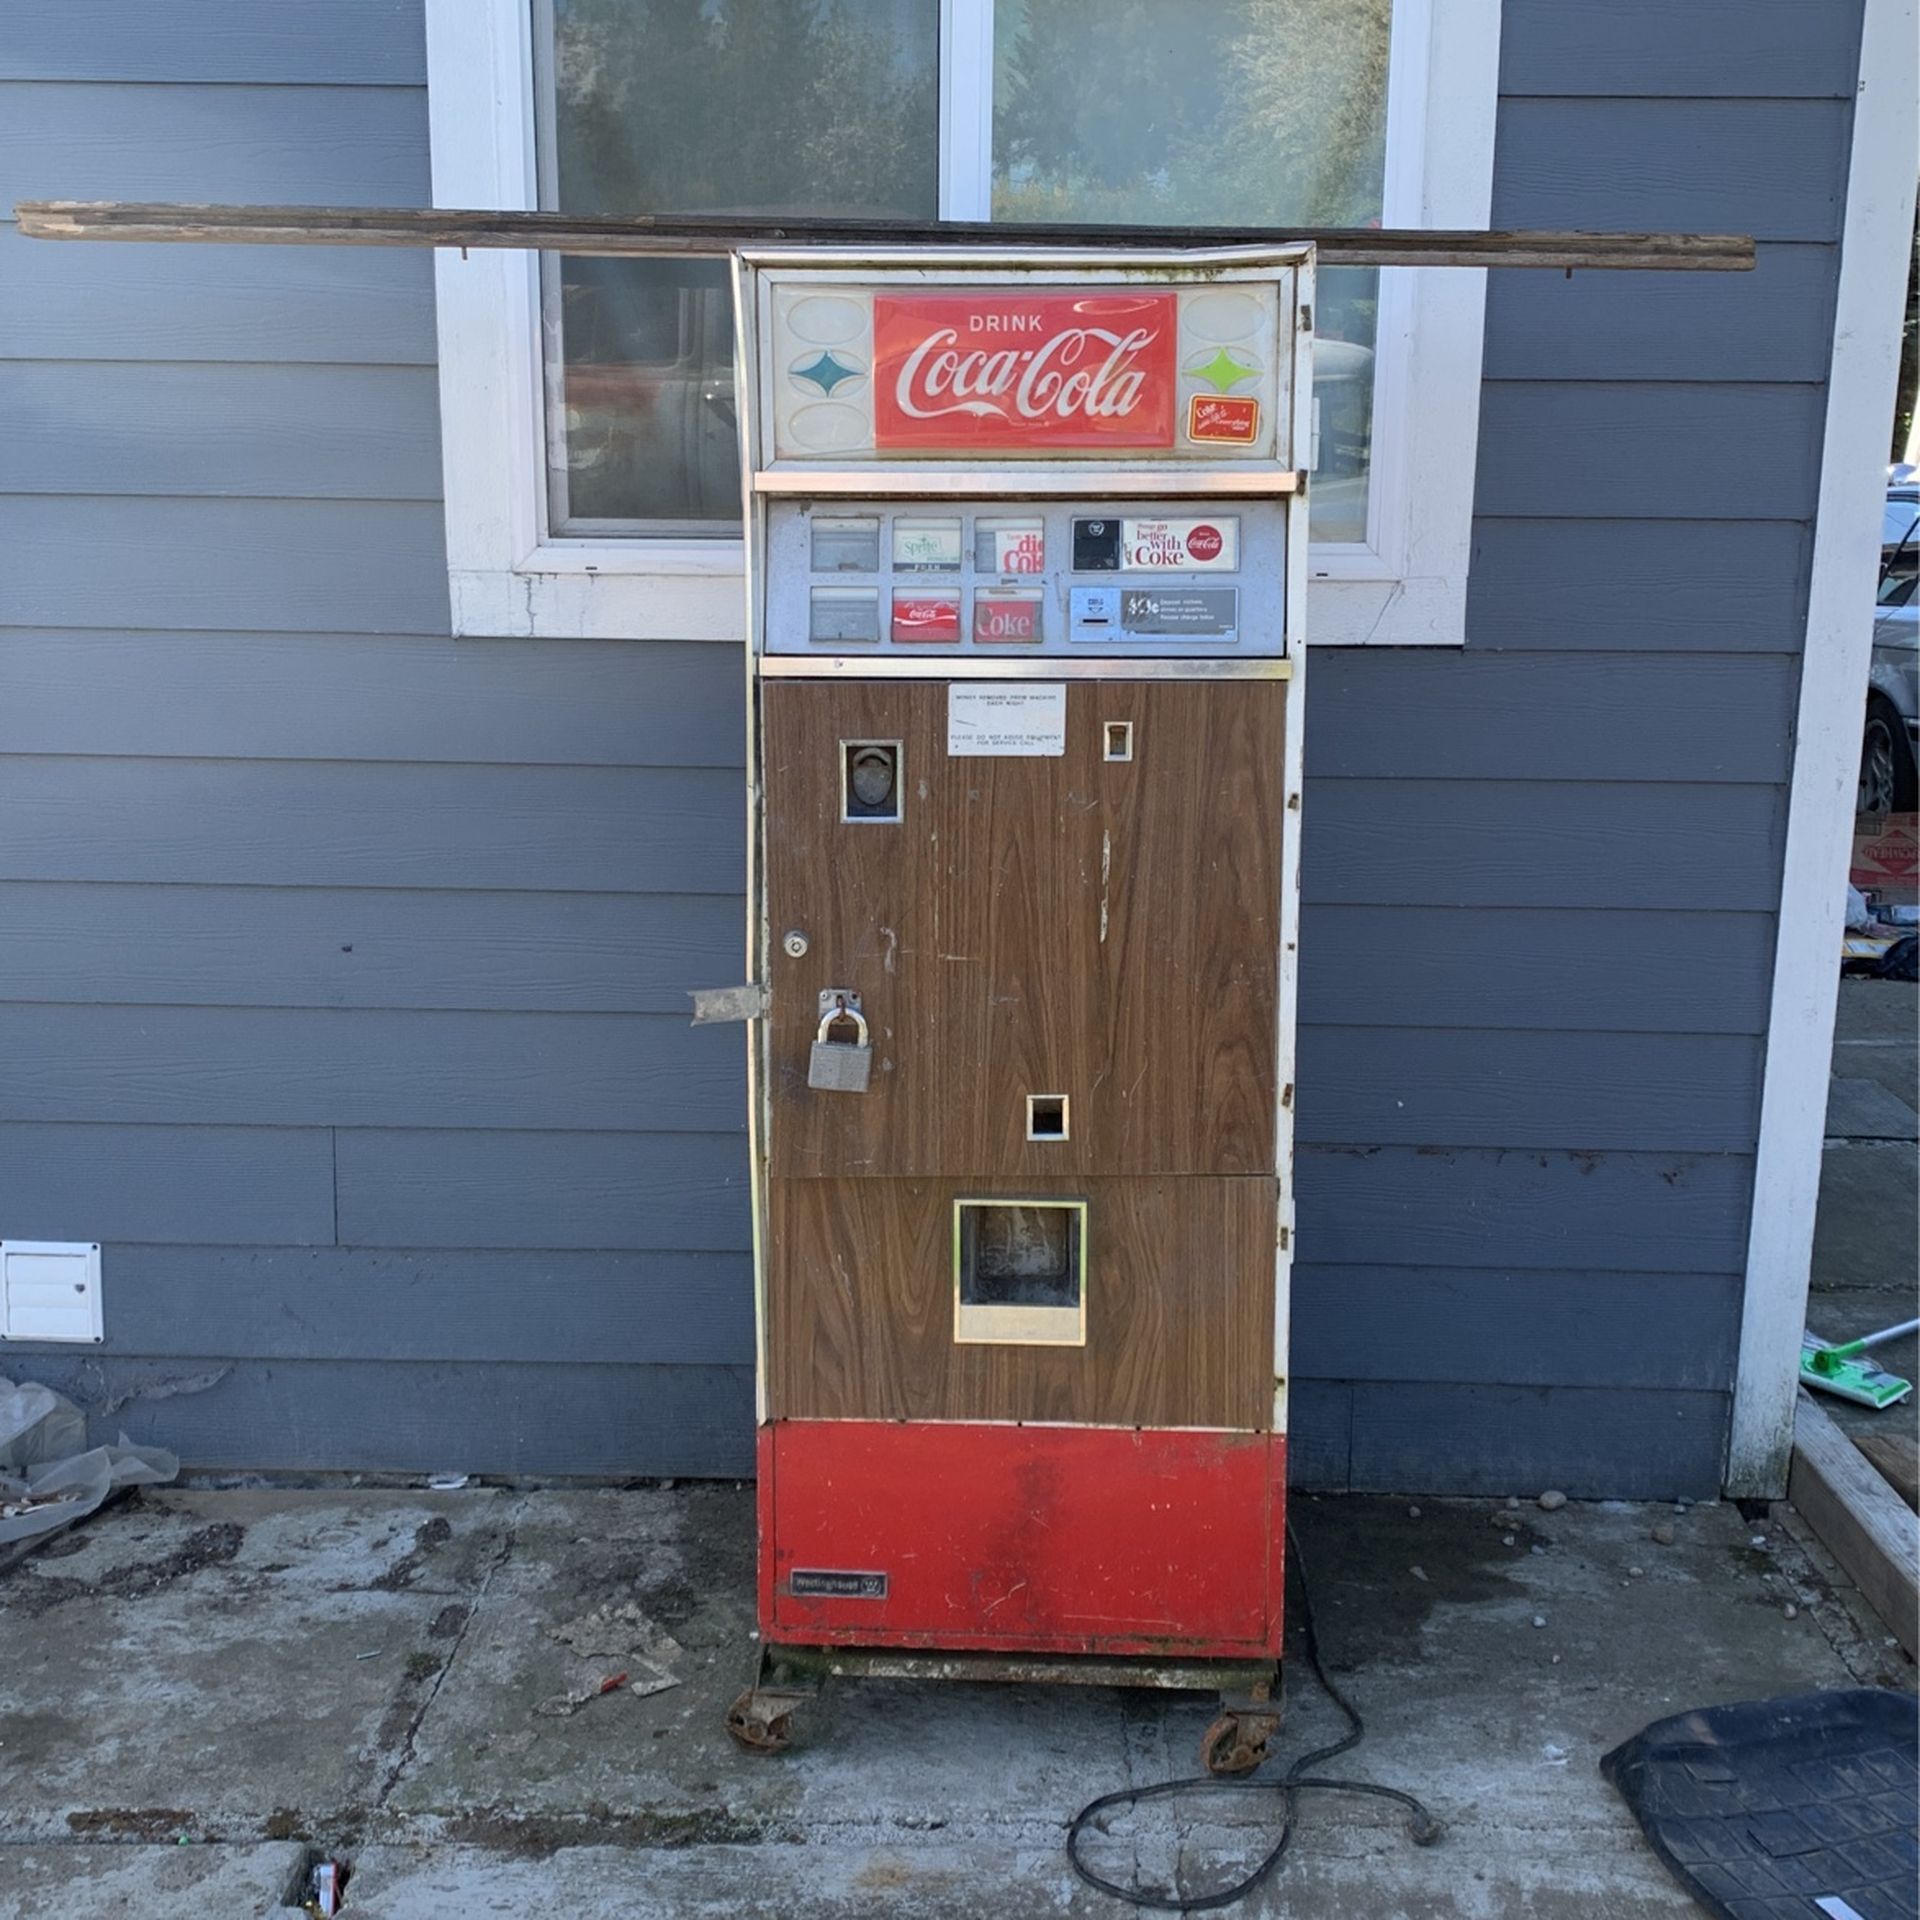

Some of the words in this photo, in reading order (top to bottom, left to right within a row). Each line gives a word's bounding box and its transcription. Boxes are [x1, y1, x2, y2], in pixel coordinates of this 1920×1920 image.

[970, 314, 1043, 333] DRINK
[896, 326, 1160, 420] Coca-Cola
[1137, 529, 1169, 541] better
[1157, 523, 1169, 532] go
[904, 538, 938, 557] Sprite
[1149, 535, 1181, 550] with
[1135, 546, 1185, 566] Coke
